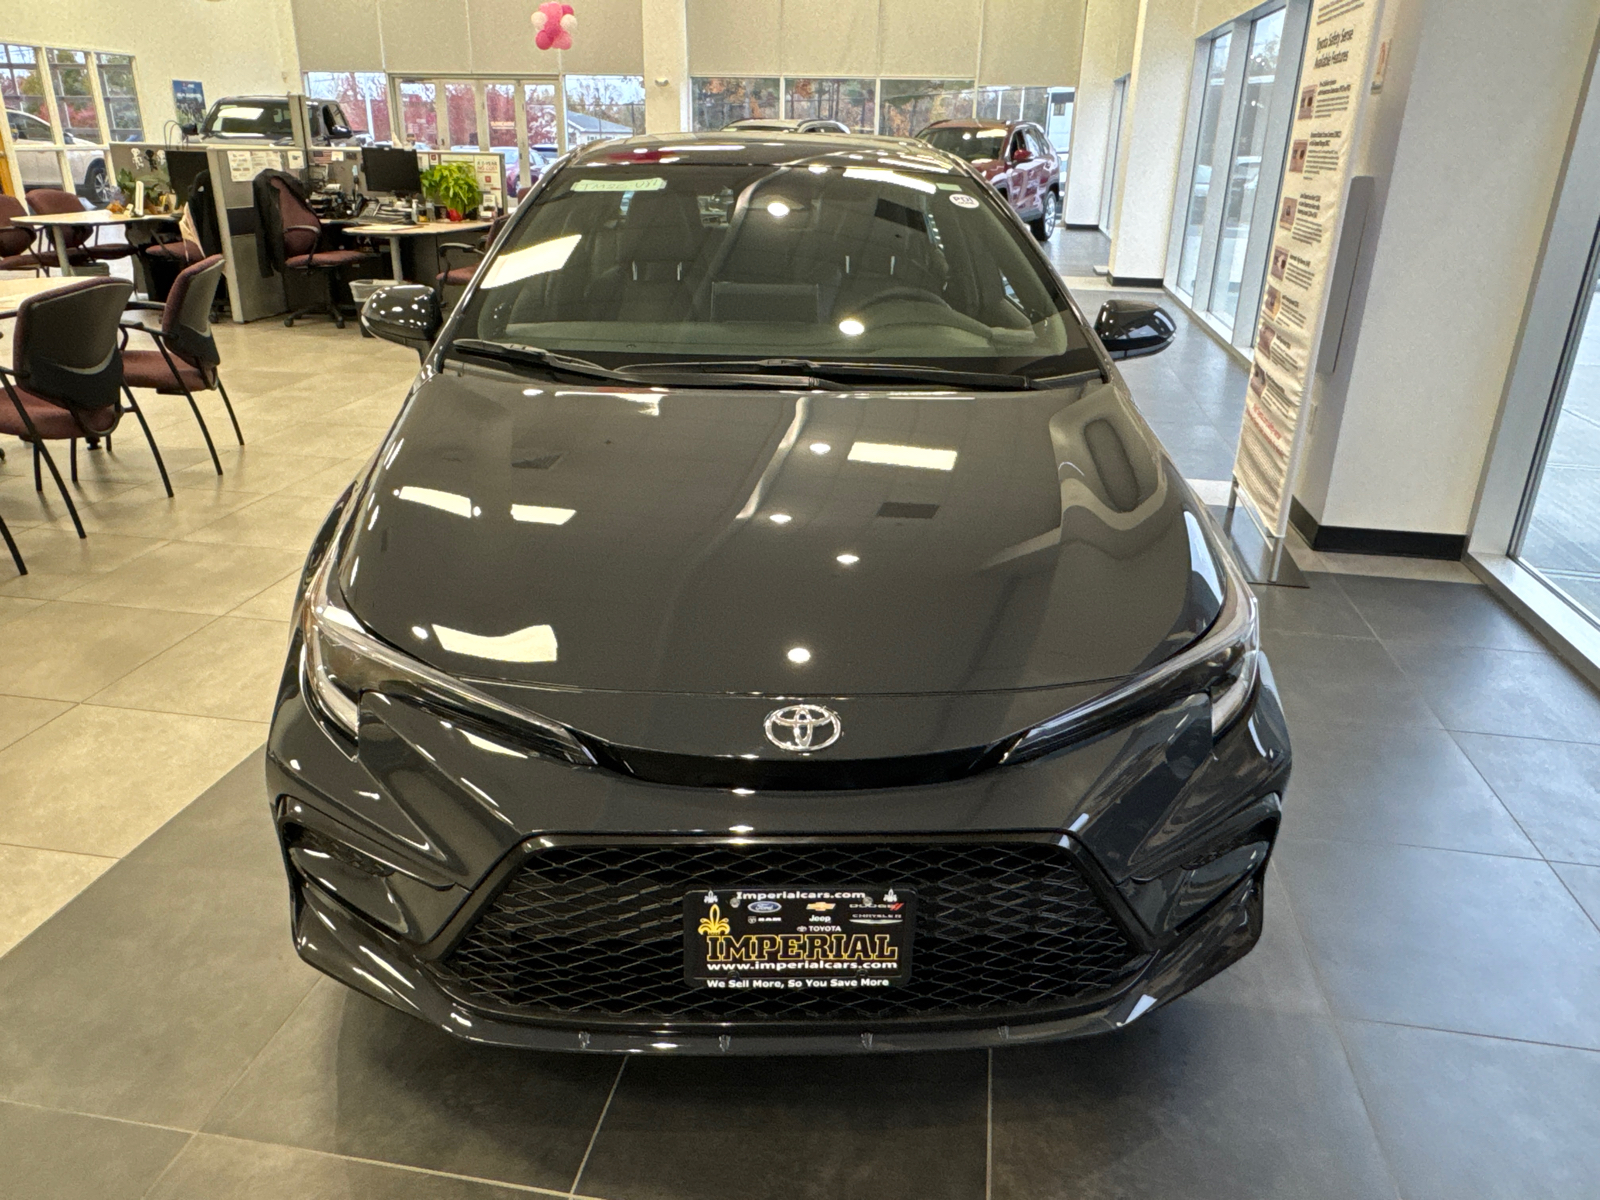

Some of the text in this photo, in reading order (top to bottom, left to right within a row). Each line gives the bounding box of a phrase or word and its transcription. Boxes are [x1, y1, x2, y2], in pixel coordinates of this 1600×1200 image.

[736, 891, 865, 900] Imperialcars.com
[809, 915, 831, 923] Jeep
[706, 934, 898, 961] IMPERIAL
[706, 960, 898, 971] www.imperialcars.com
[706, 978, 889, 989] We Sell More, So You Save More
